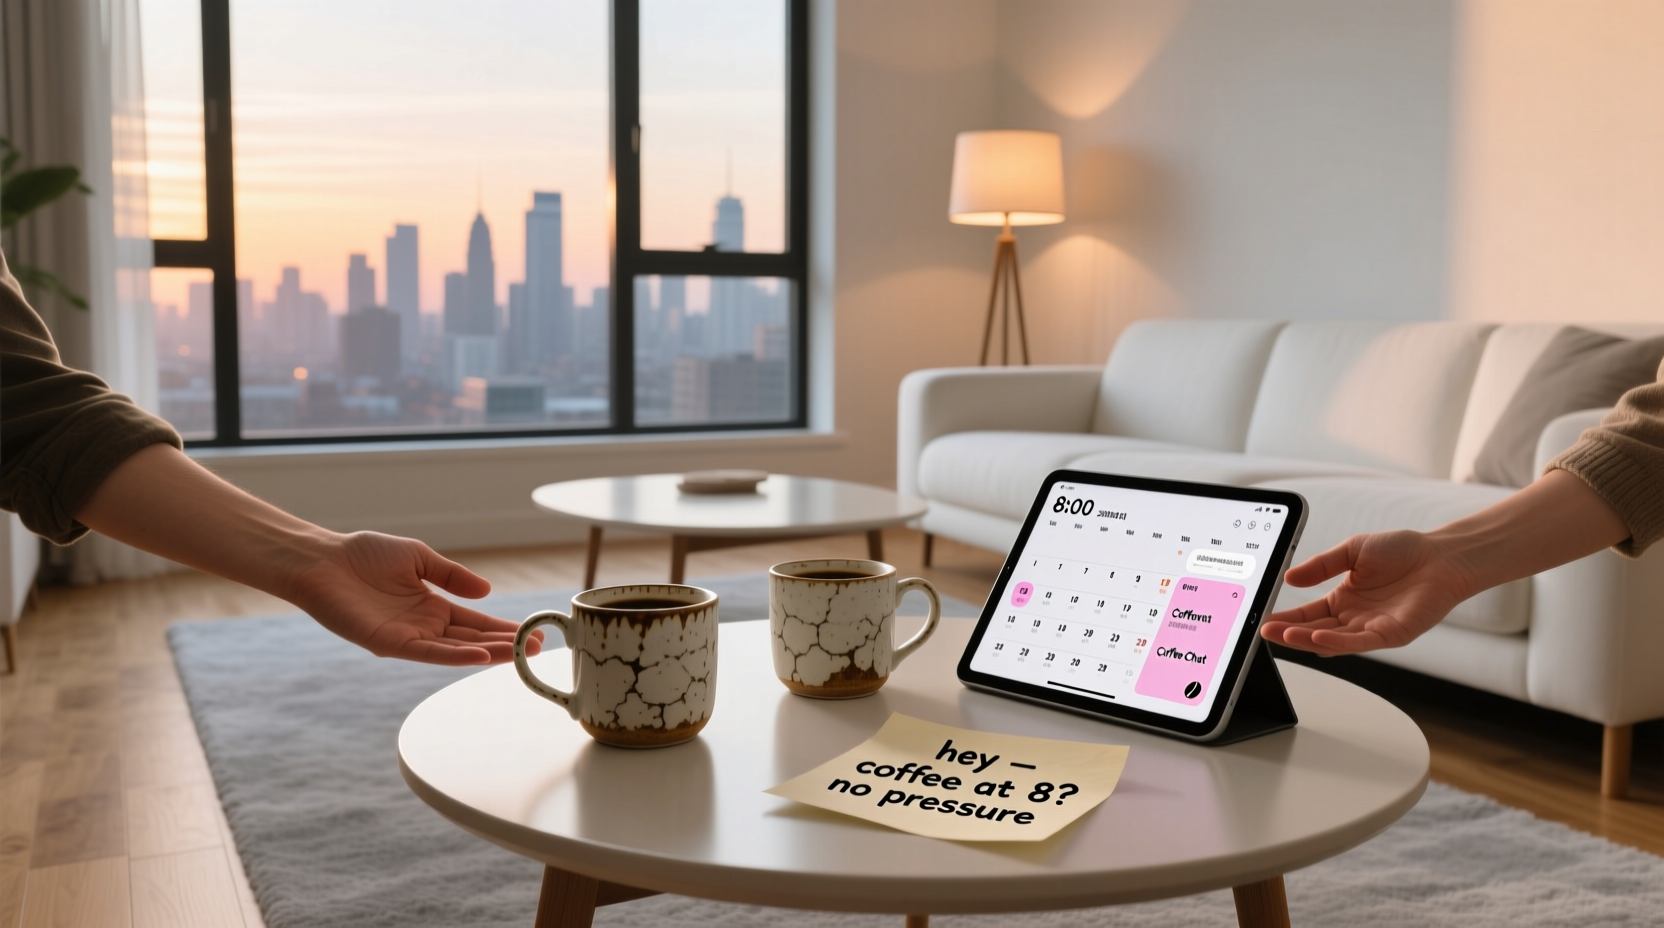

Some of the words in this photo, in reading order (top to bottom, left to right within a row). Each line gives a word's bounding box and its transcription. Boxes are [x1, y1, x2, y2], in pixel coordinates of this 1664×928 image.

[1052, 495, 1095, 517] 8:00
[935, 739, 1000, 774] hey
[827, 778, 872, 797] no
[877, 789, 1035, 825] pressure
[856, 761, 962, 790] coffee
[973, 780, 1015, 799] at
[1027, 782, 1079, 806] 8?
